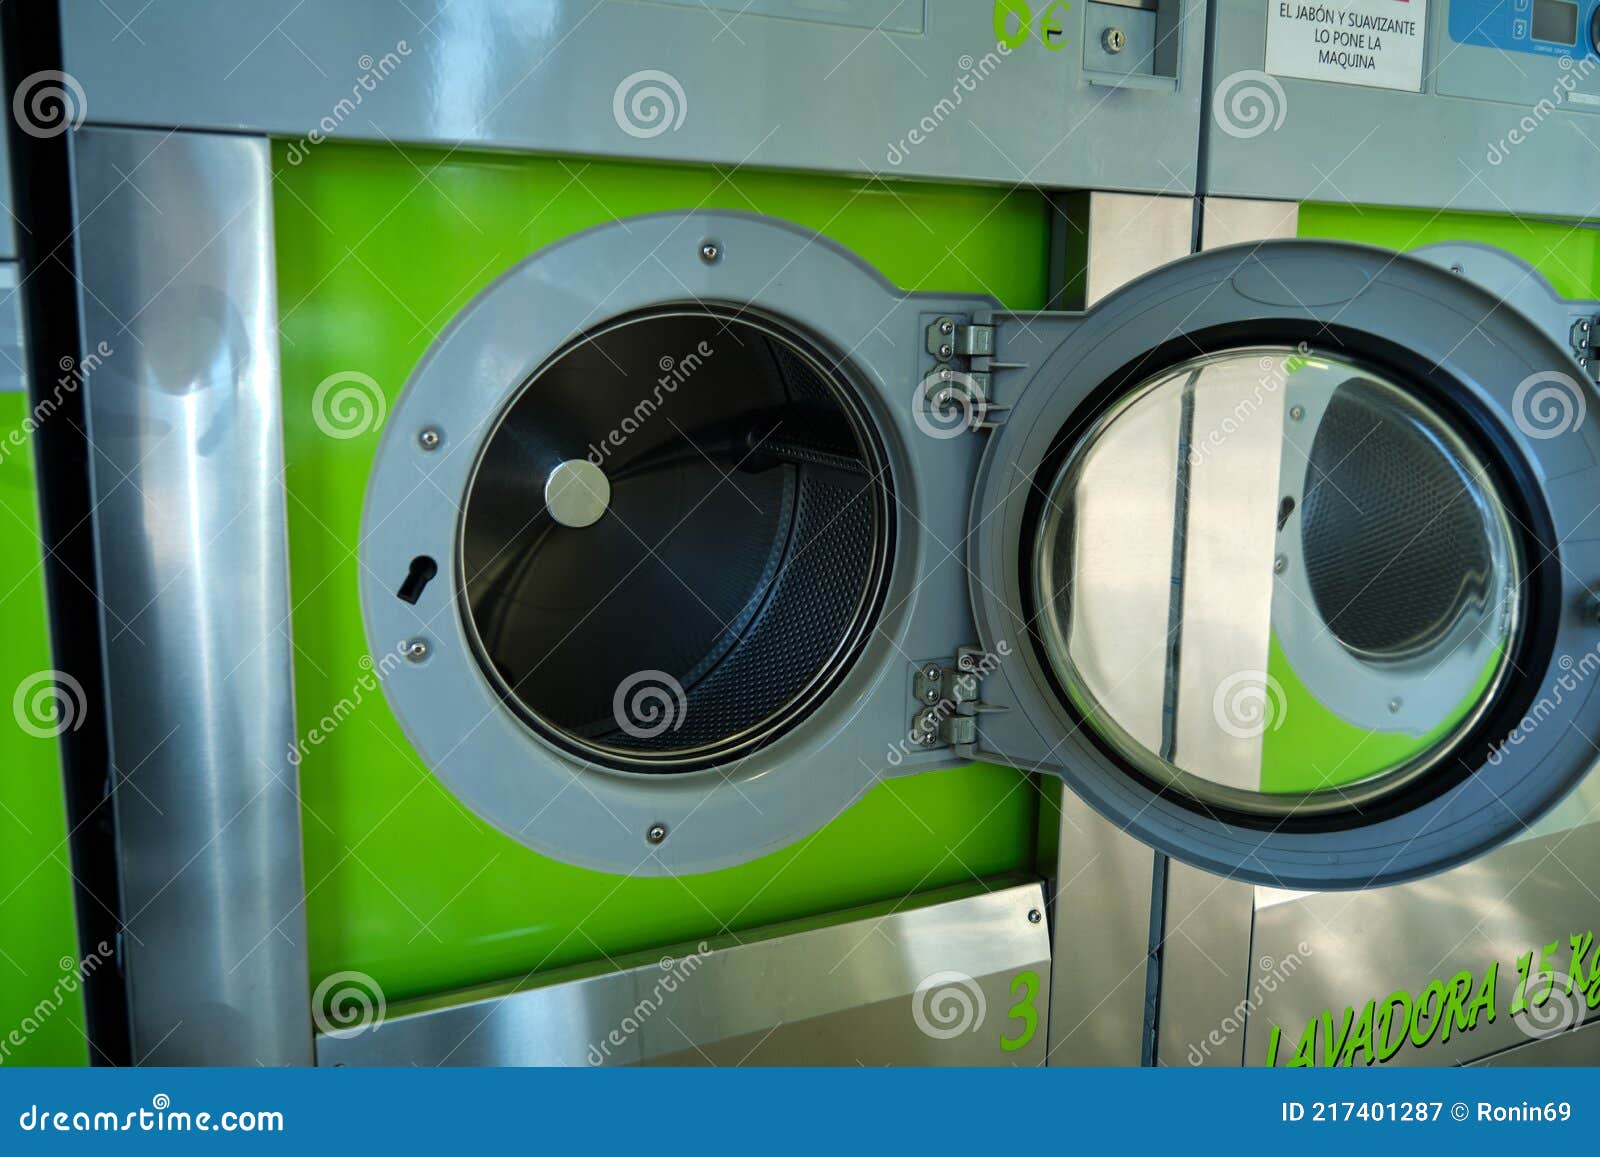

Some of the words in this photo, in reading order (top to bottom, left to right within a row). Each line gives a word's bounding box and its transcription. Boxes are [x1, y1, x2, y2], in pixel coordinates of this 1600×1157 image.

[1279, 2, 1292, 18] EL
[1295, 4, 1334, 24] JABÓN
[1337, 11, 1346, 25] Y
[1349, 12, 1416, 36] SUAVIZANTE
[1314, 28, 1330, 44] LO
[1333, 31, 1365, 49] PONE
[1368, 35, 1382, 51] LA
[1318, 50, 1376, 70] MAQUINA
[1000, 970, 1040, 1052] 3
[1265, 960, 1499, 1067] LAVADORA
[1509, 940, 1559, 1018] 15
